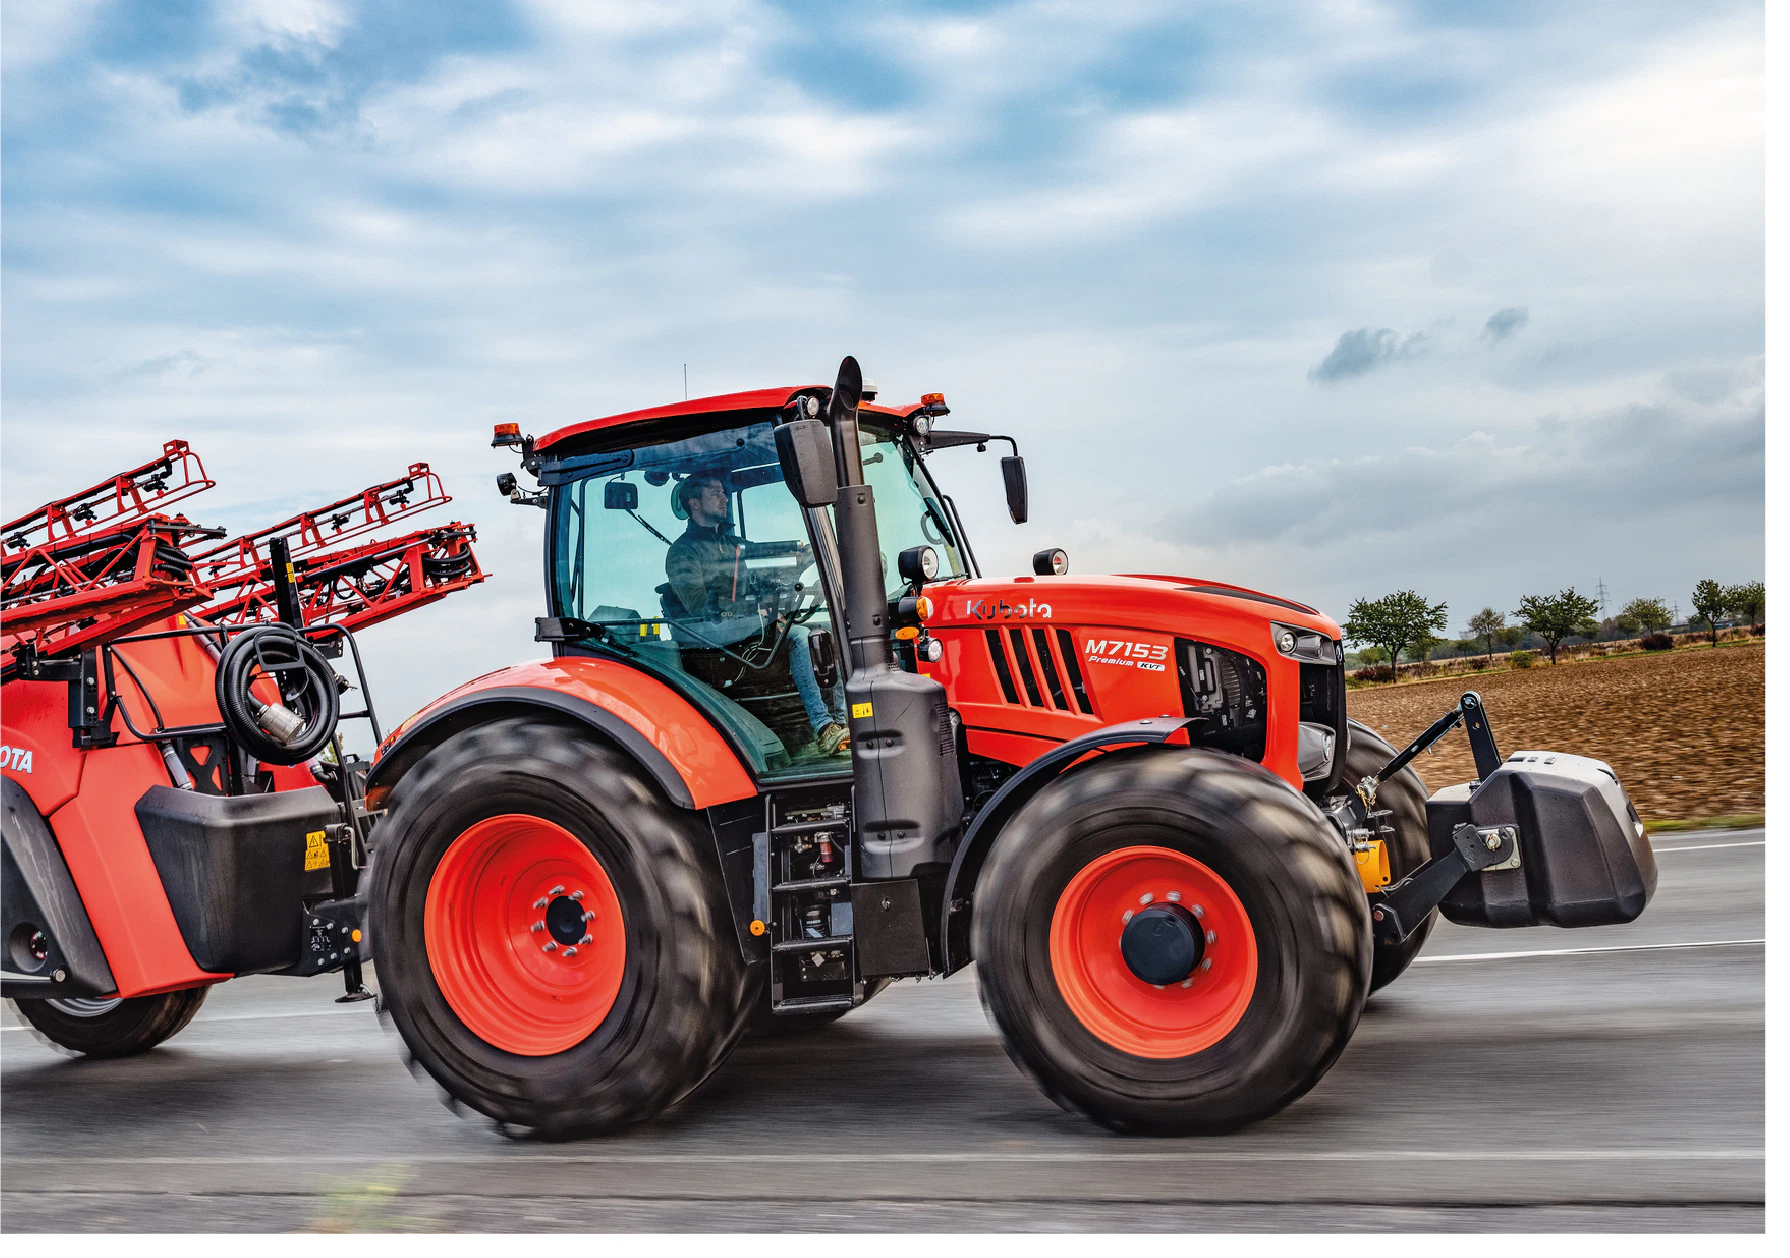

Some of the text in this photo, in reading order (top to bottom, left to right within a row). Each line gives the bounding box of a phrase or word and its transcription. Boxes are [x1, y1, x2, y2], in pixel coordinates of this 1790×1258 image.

[966, 598, 1053, 620] Kubota
[1085, 639, 1169, 661] M7153
[1088, 655, 1163, 670] Premium KVT
